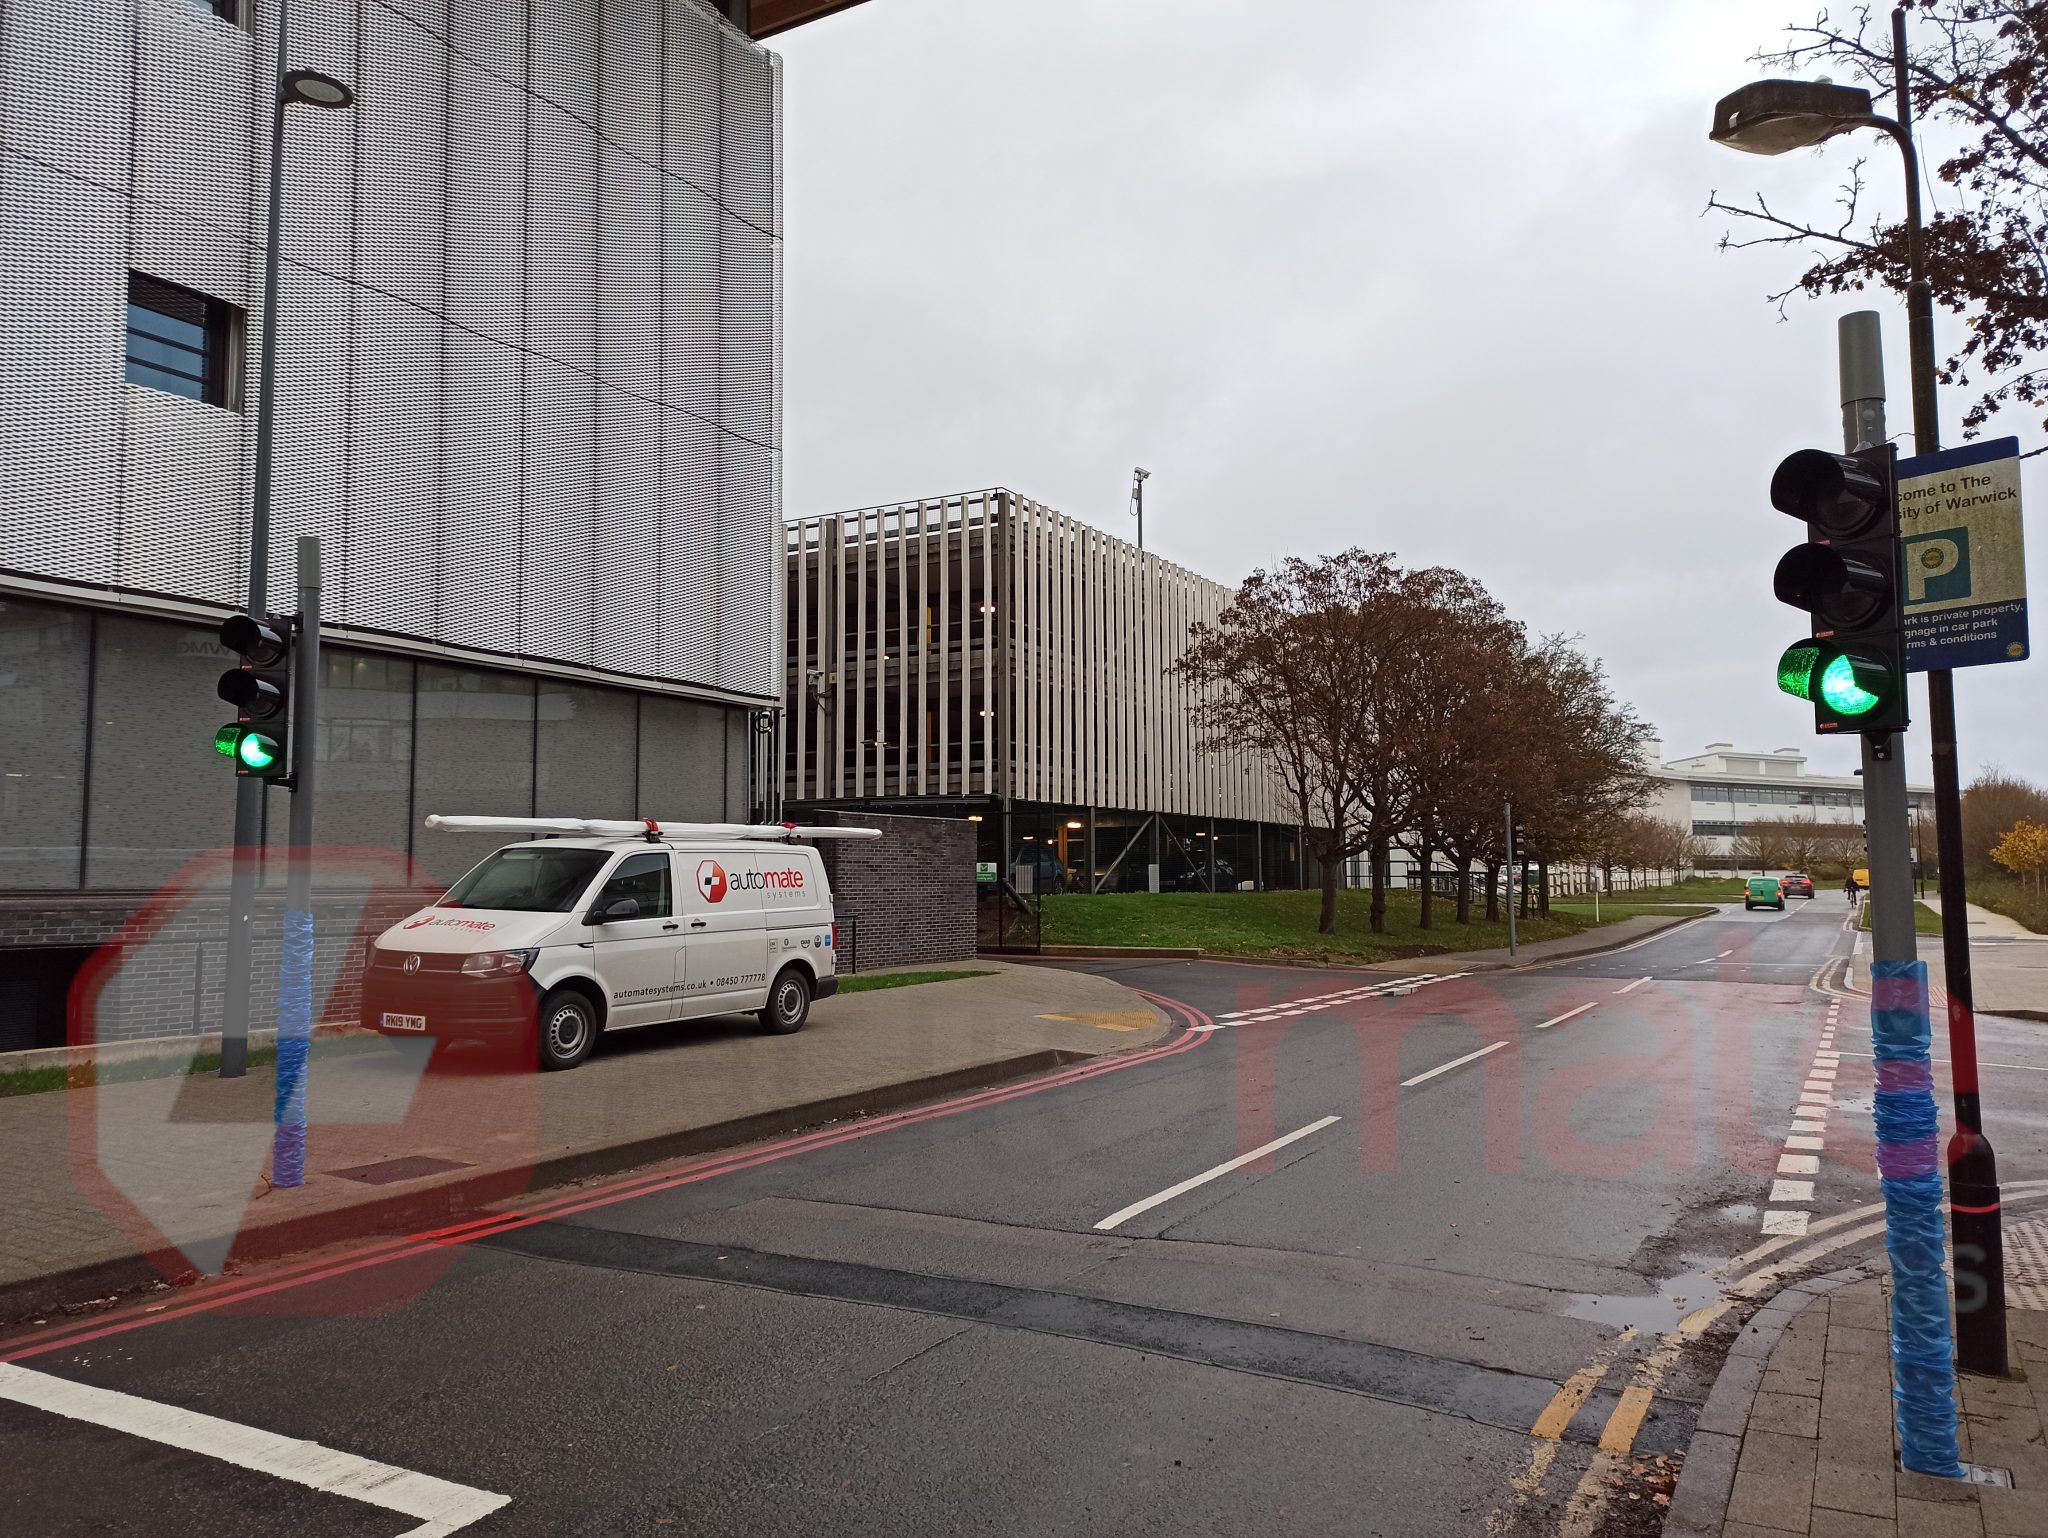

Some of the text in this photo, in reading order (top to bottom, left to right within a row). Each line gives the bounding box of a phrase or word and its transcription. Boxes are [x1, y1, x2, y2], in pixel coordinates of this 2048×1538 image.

[1940, 482, 1956, 494] to
[1960, 476, 1991, 490] The
[1925, 501, 1941, 515] of
[1946, 487, 2017, 511] Warwick
[1906, 538, 1959, 601] P
[1920, 615, 1930, 623] is
[1932, 609, 1970, 624] private
[1972, 602, 2024, 617] property,
[1904, 618, 1998, 640] gnage in car park
[1906, 630, 1997, 649] rms & conditions
[729, 867, 804, 891] automate
[766, 890, 806, 901] systems
[428, 918, 496, 931] automate
[613, 973, 766, 999] automatesystems.co.uk 08450 777778
[385, 1014, 404, 1027] RK19
